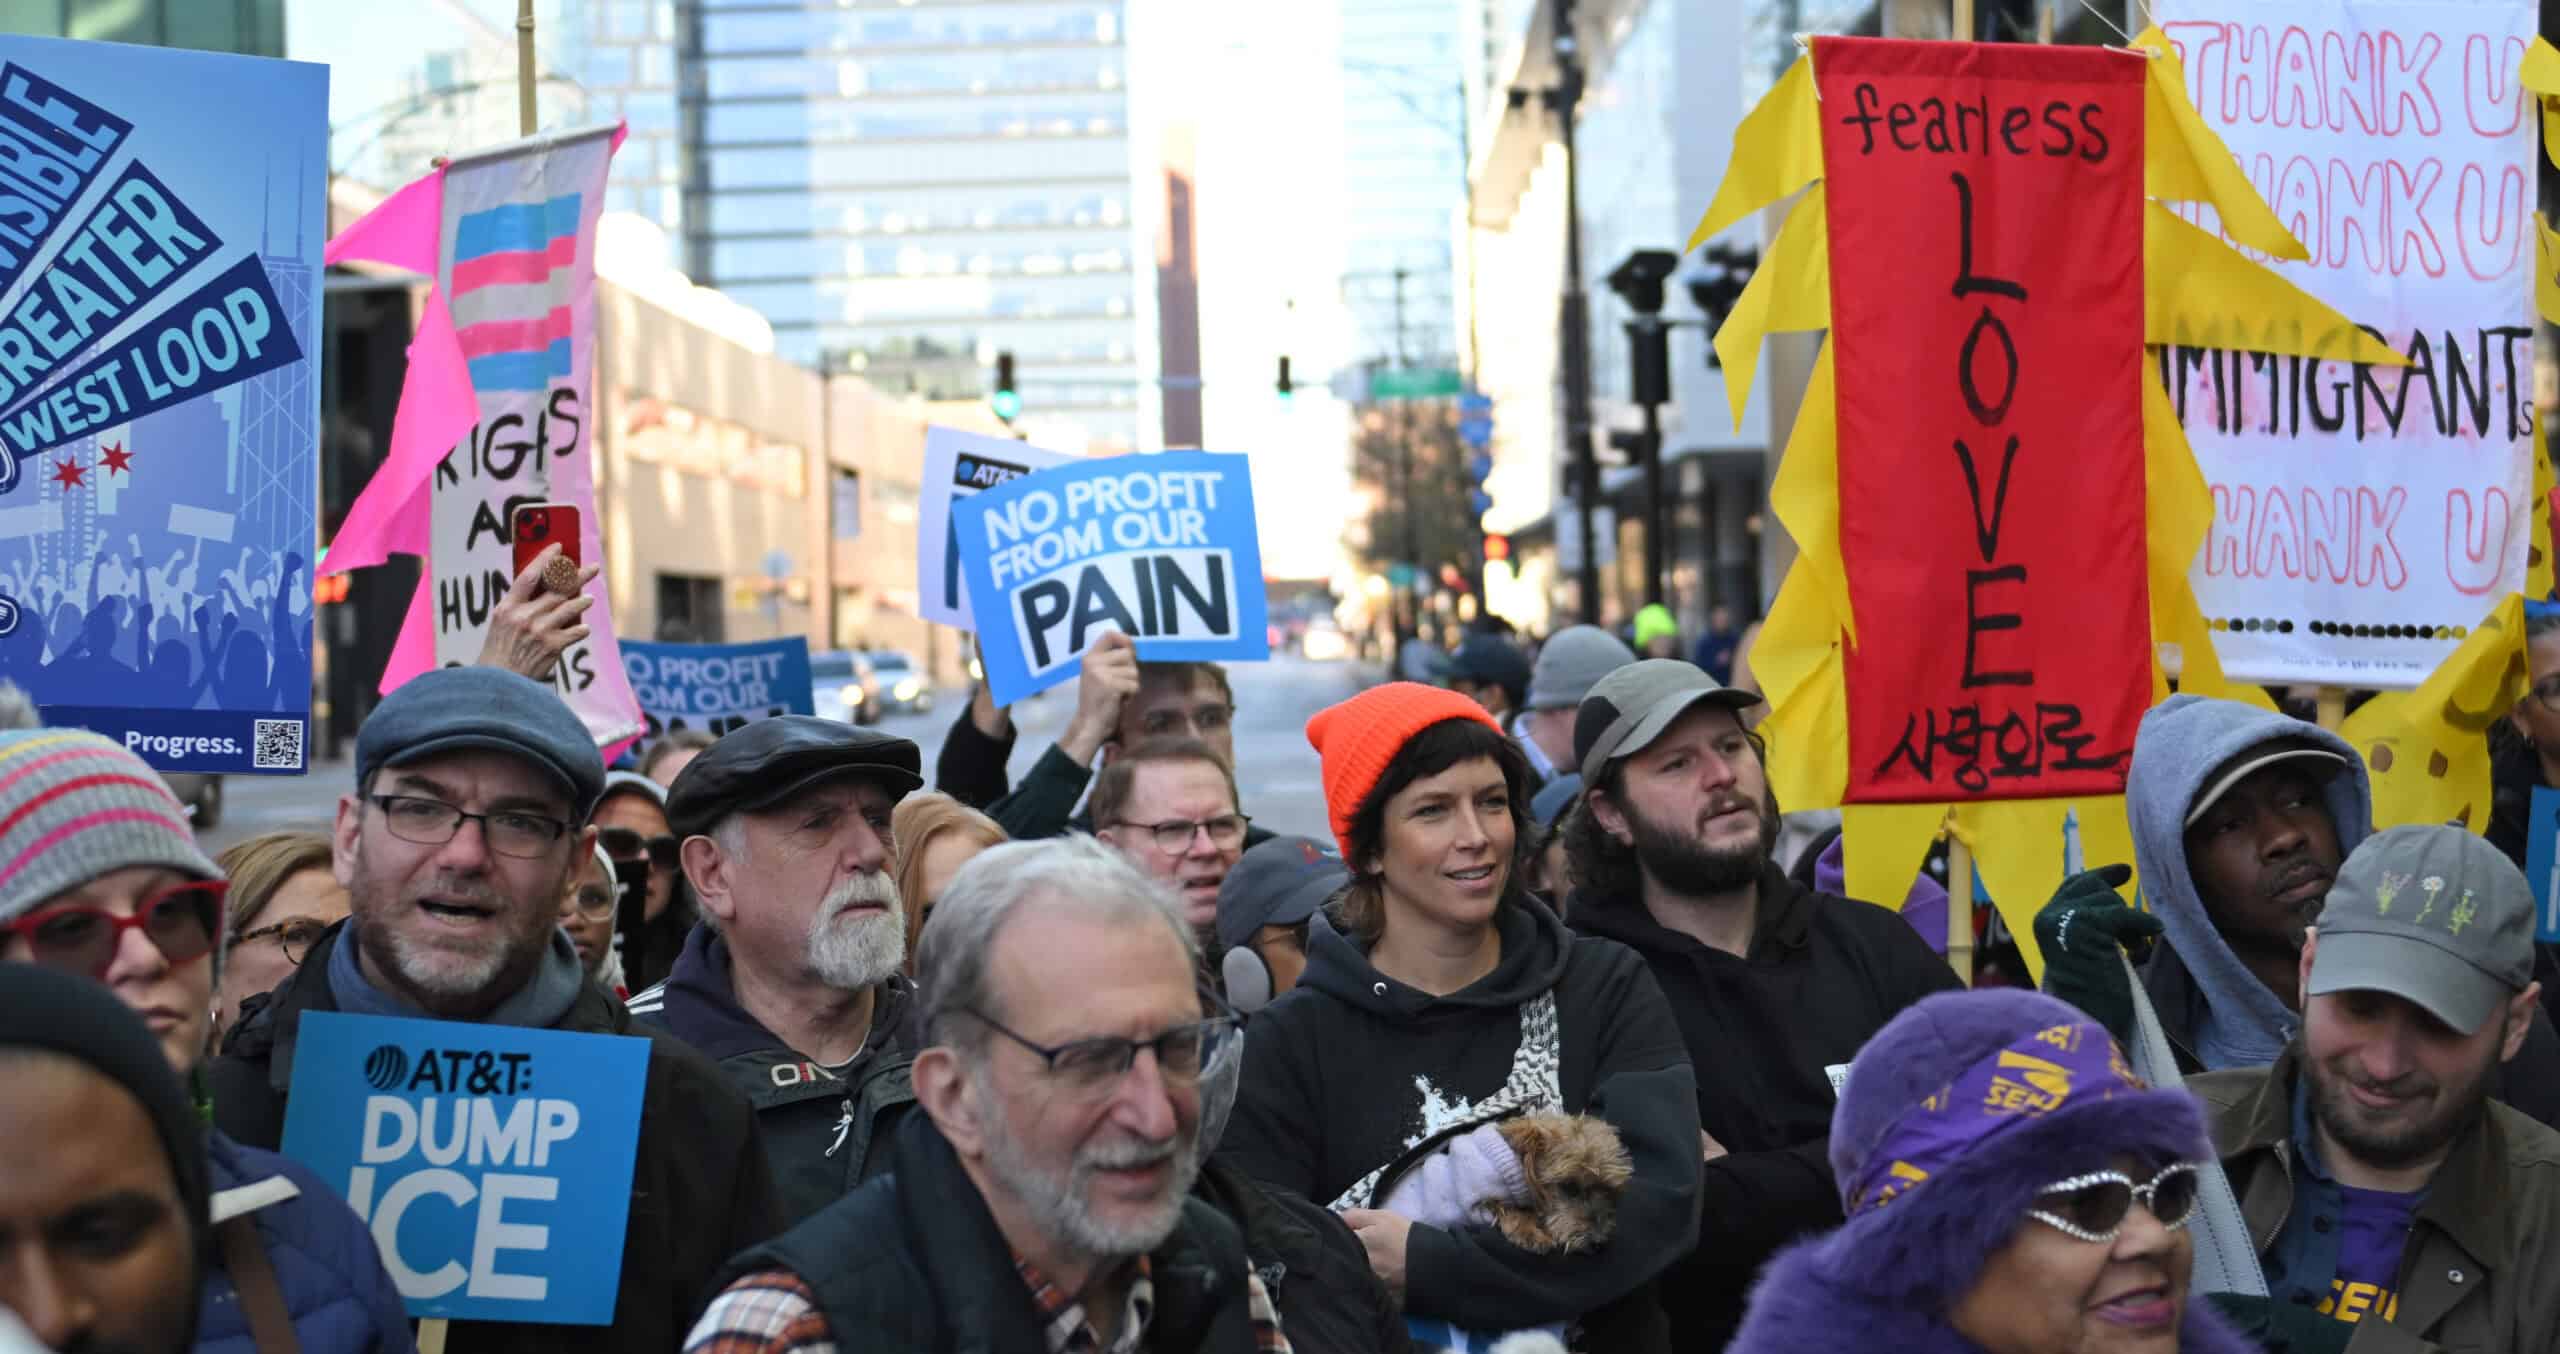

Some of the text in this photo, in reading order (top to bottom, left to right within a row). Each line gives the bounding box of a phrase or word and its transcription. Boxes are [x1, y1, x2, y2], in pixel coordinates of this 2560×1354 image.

[2162, 21, 2526, 137] THANK U
[1842, 83, 2109, 164] fearless
[2180, 152, 2525, 281] ANK U
[2, 287, 271, 451] WEST LOOP
[1951, 171, 2034, 690] LOVE
[972, 463, 1025, 486] AT&
[983, 472, 1222, 549] NO PROFIT
[989, 520, 1104, 591] FROM
[1112, 508, 1209, 549] OUR
[2204, 483, 2510, 594] HANK U
[1019, 554, 1230, 669] PAIN
[623, 652, 654, 681] O
[658, 652, 785, 685] PROFIT
[636, 680, 769, 712] OM OUR
[125, 731, 243, 758] Progress.
[361, 1095, 580, 1167] DUMP
